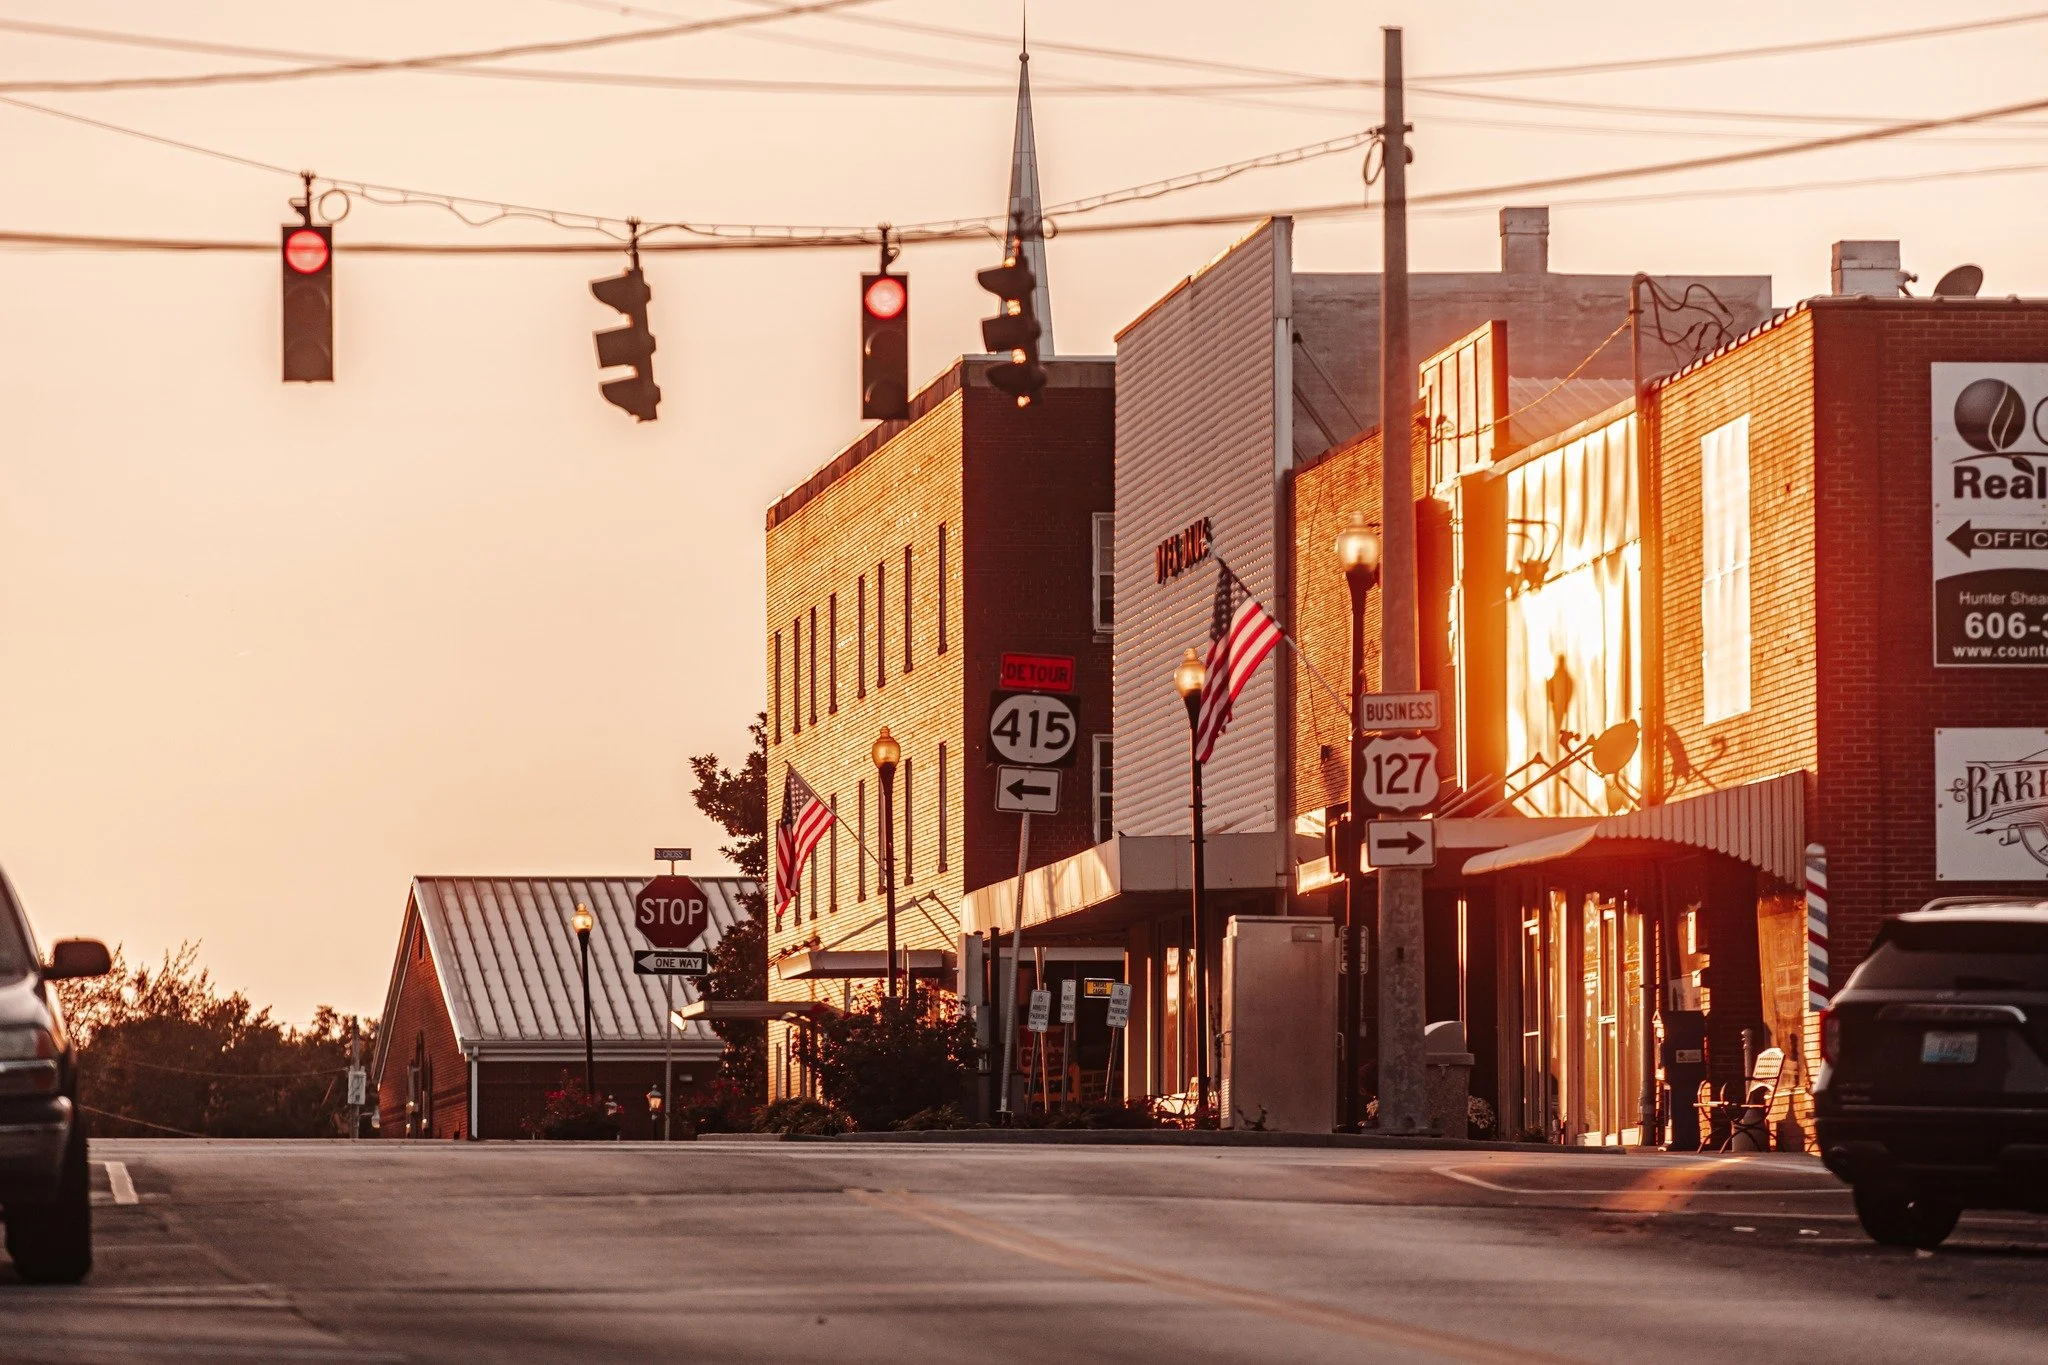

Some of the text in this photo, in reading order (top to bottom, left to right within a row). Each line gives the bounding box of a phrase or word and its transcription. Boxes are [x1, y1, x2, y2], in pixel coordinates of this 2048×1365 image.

[1954, 466, 2047, 499] Real
[1973, 532, 2048, 548] OFFIC
[1959, 591, 2006, 605] Hunter
[1006, 663, 1069, 684] DETOUR
[1366, 701, 1433, 722] BUSINESS
[992, 708, 1071, 750] 415
[1372, 752, 1432, 795] 127
[640, 898, 704, 925] STOP
[655, 958, 700, 968] ONE WAY
[1032, 1004, 1047, 1012] MINUTE
[1110, 1006, 1128, 1015] PARKING
[1112, 999, 1128, 1007] MINUTE
[1030, 1012, 1048, 1020] PARKING
